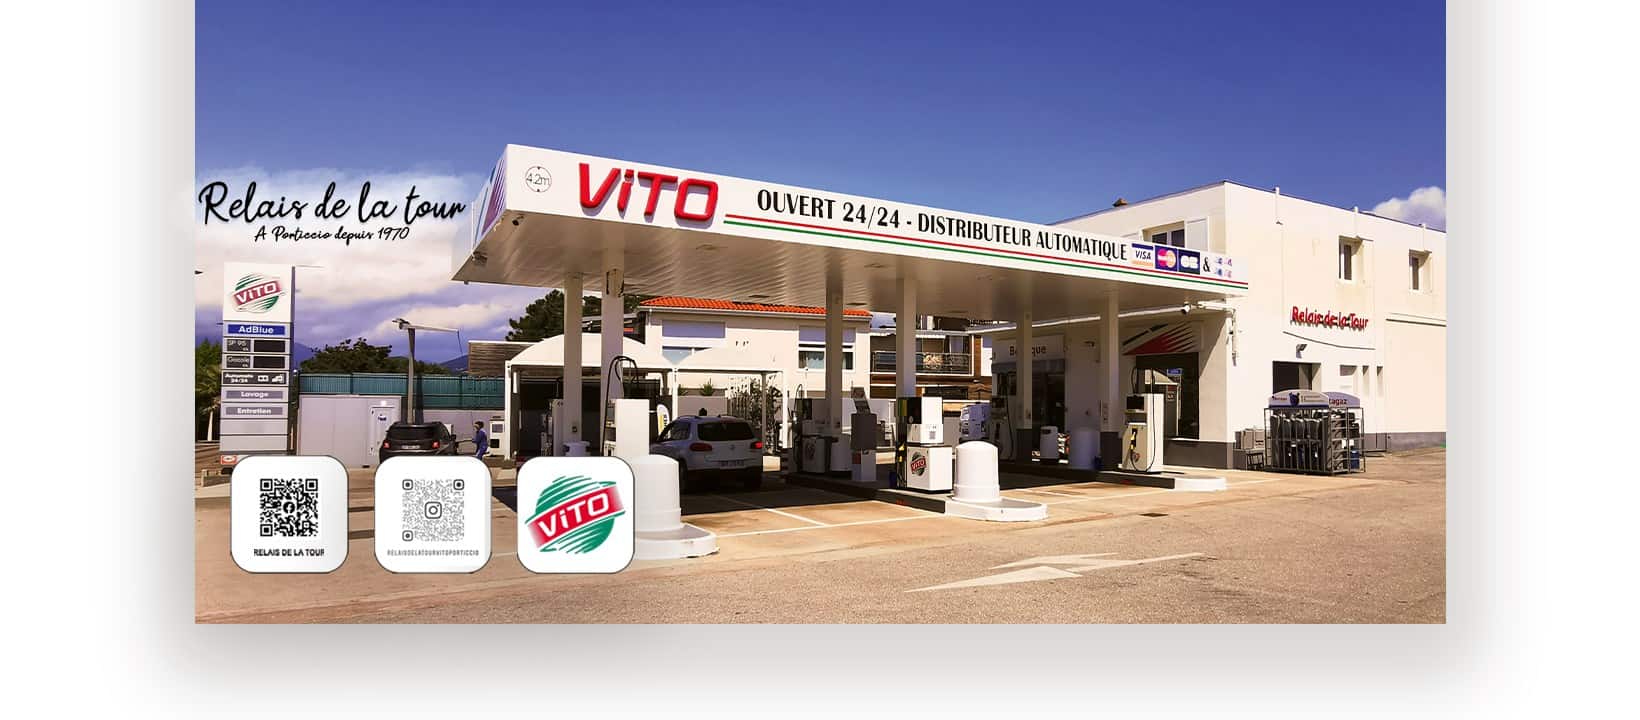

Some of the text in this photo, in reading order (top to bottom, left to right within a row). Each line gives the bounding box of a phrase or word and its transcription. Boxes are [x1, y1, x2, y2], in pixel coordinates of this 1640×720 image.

[757, 189, 836, 220] OUVERT
[842, 202, 900, 230] 24/24
[918, 212, 1032, 247] DISTRIBUTEUR
[1036, 230, 1128, 261] AUTOMATIQUE
[1135, 250, 1151, 260] VISA
[1203, 257, 1211, 272] &
[1292, 306, 1369, 329] Relais de la Tour
[238, 325, 274, 334] AdBlue
[237, 407, 272, 415] Entretien
